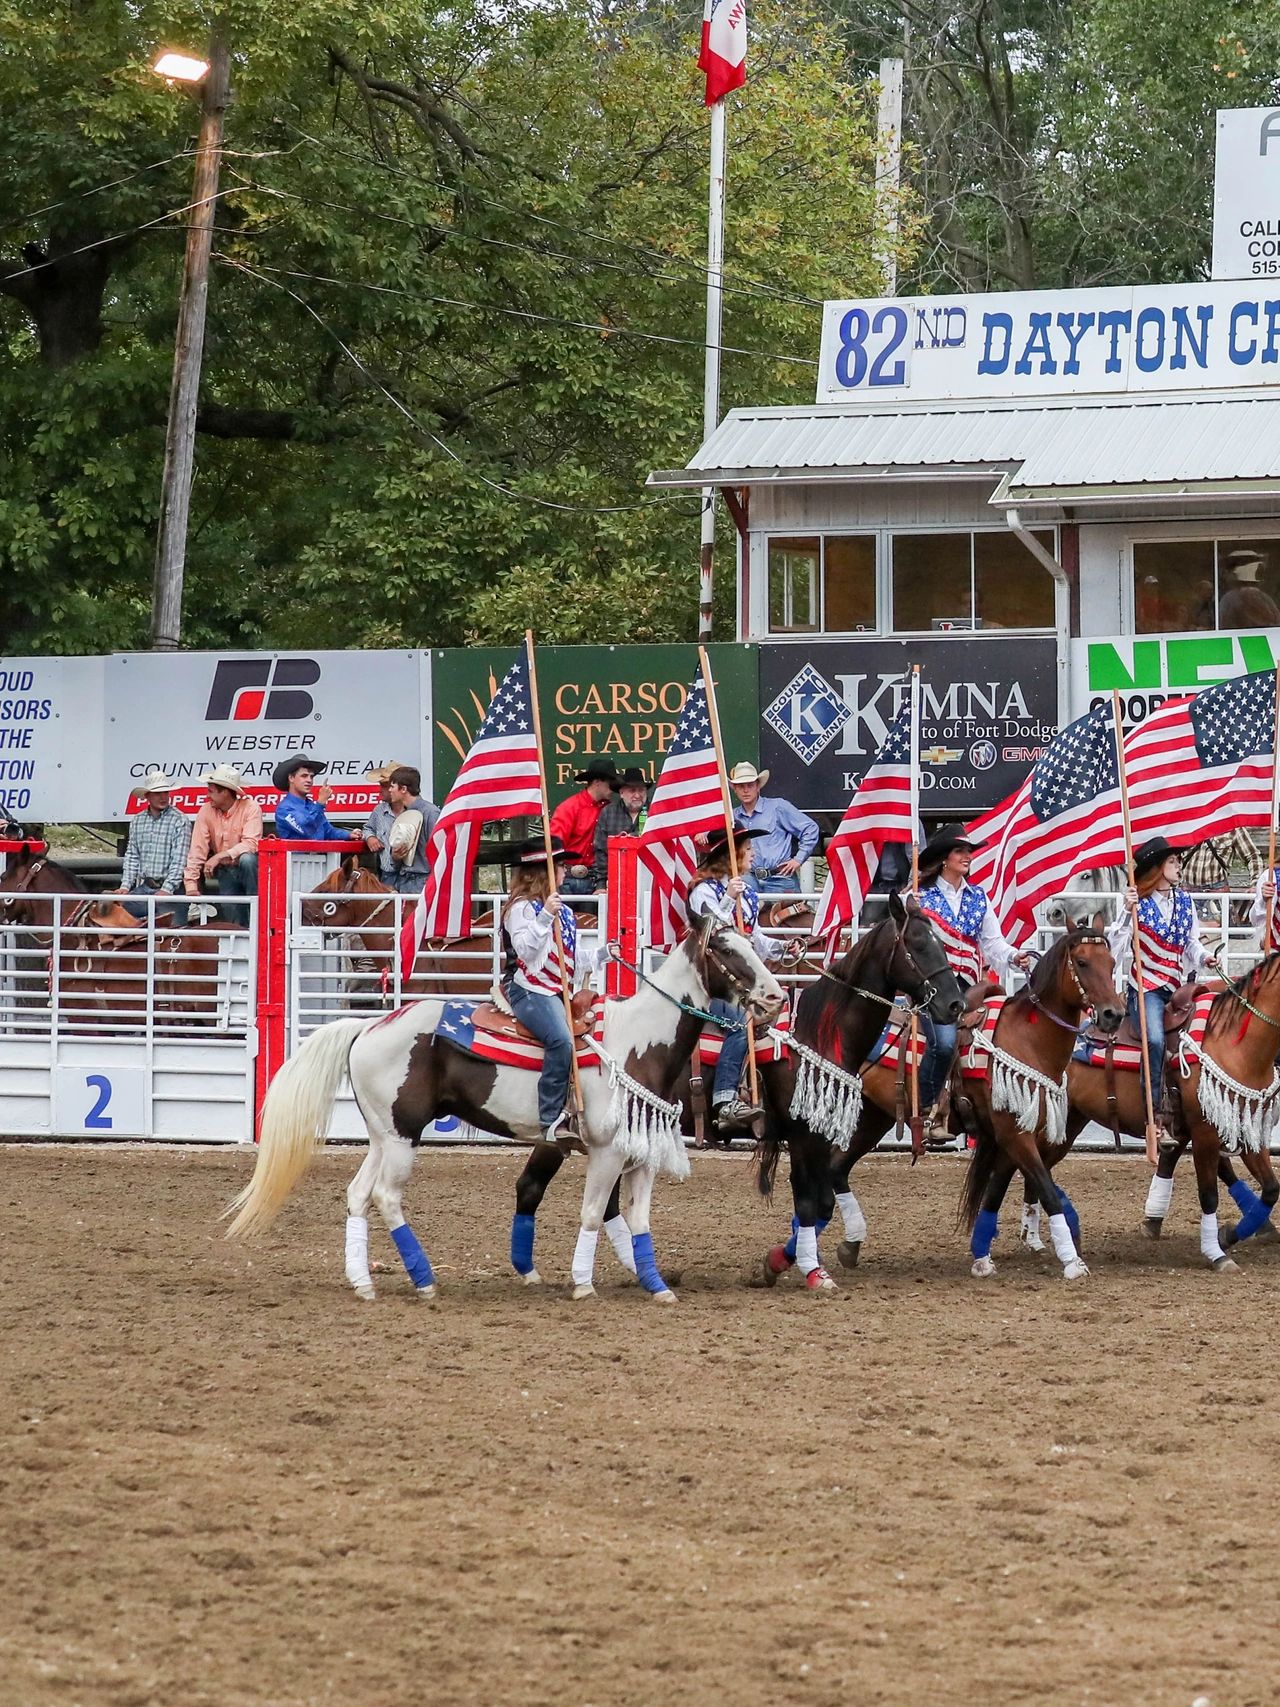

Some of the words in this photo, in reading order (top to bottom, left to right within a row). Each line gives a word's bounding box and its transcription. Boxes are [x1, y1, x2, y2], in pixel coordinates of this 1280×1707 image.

[977, 305, 1214, 376] DAYTON
[555, 682, 718, 715] CARSO
[771, 673, 807, 713] COUNT
[810, 674, 846, 713] ON
[0, 728, 34, 749] THE
[205, 734, 317, 751] WEBSTER
[771, 715, 806, 755] KEMNA
[809, 717, 846, 756] KEMNA
[943, 720, 962, 739] of
[965, 721, 999, 738] Fort
[1004, 719, 1059, 742] Dodge
[1002, 746, 1049, 762] GM
[84, 1074, 113, 1128] 2
